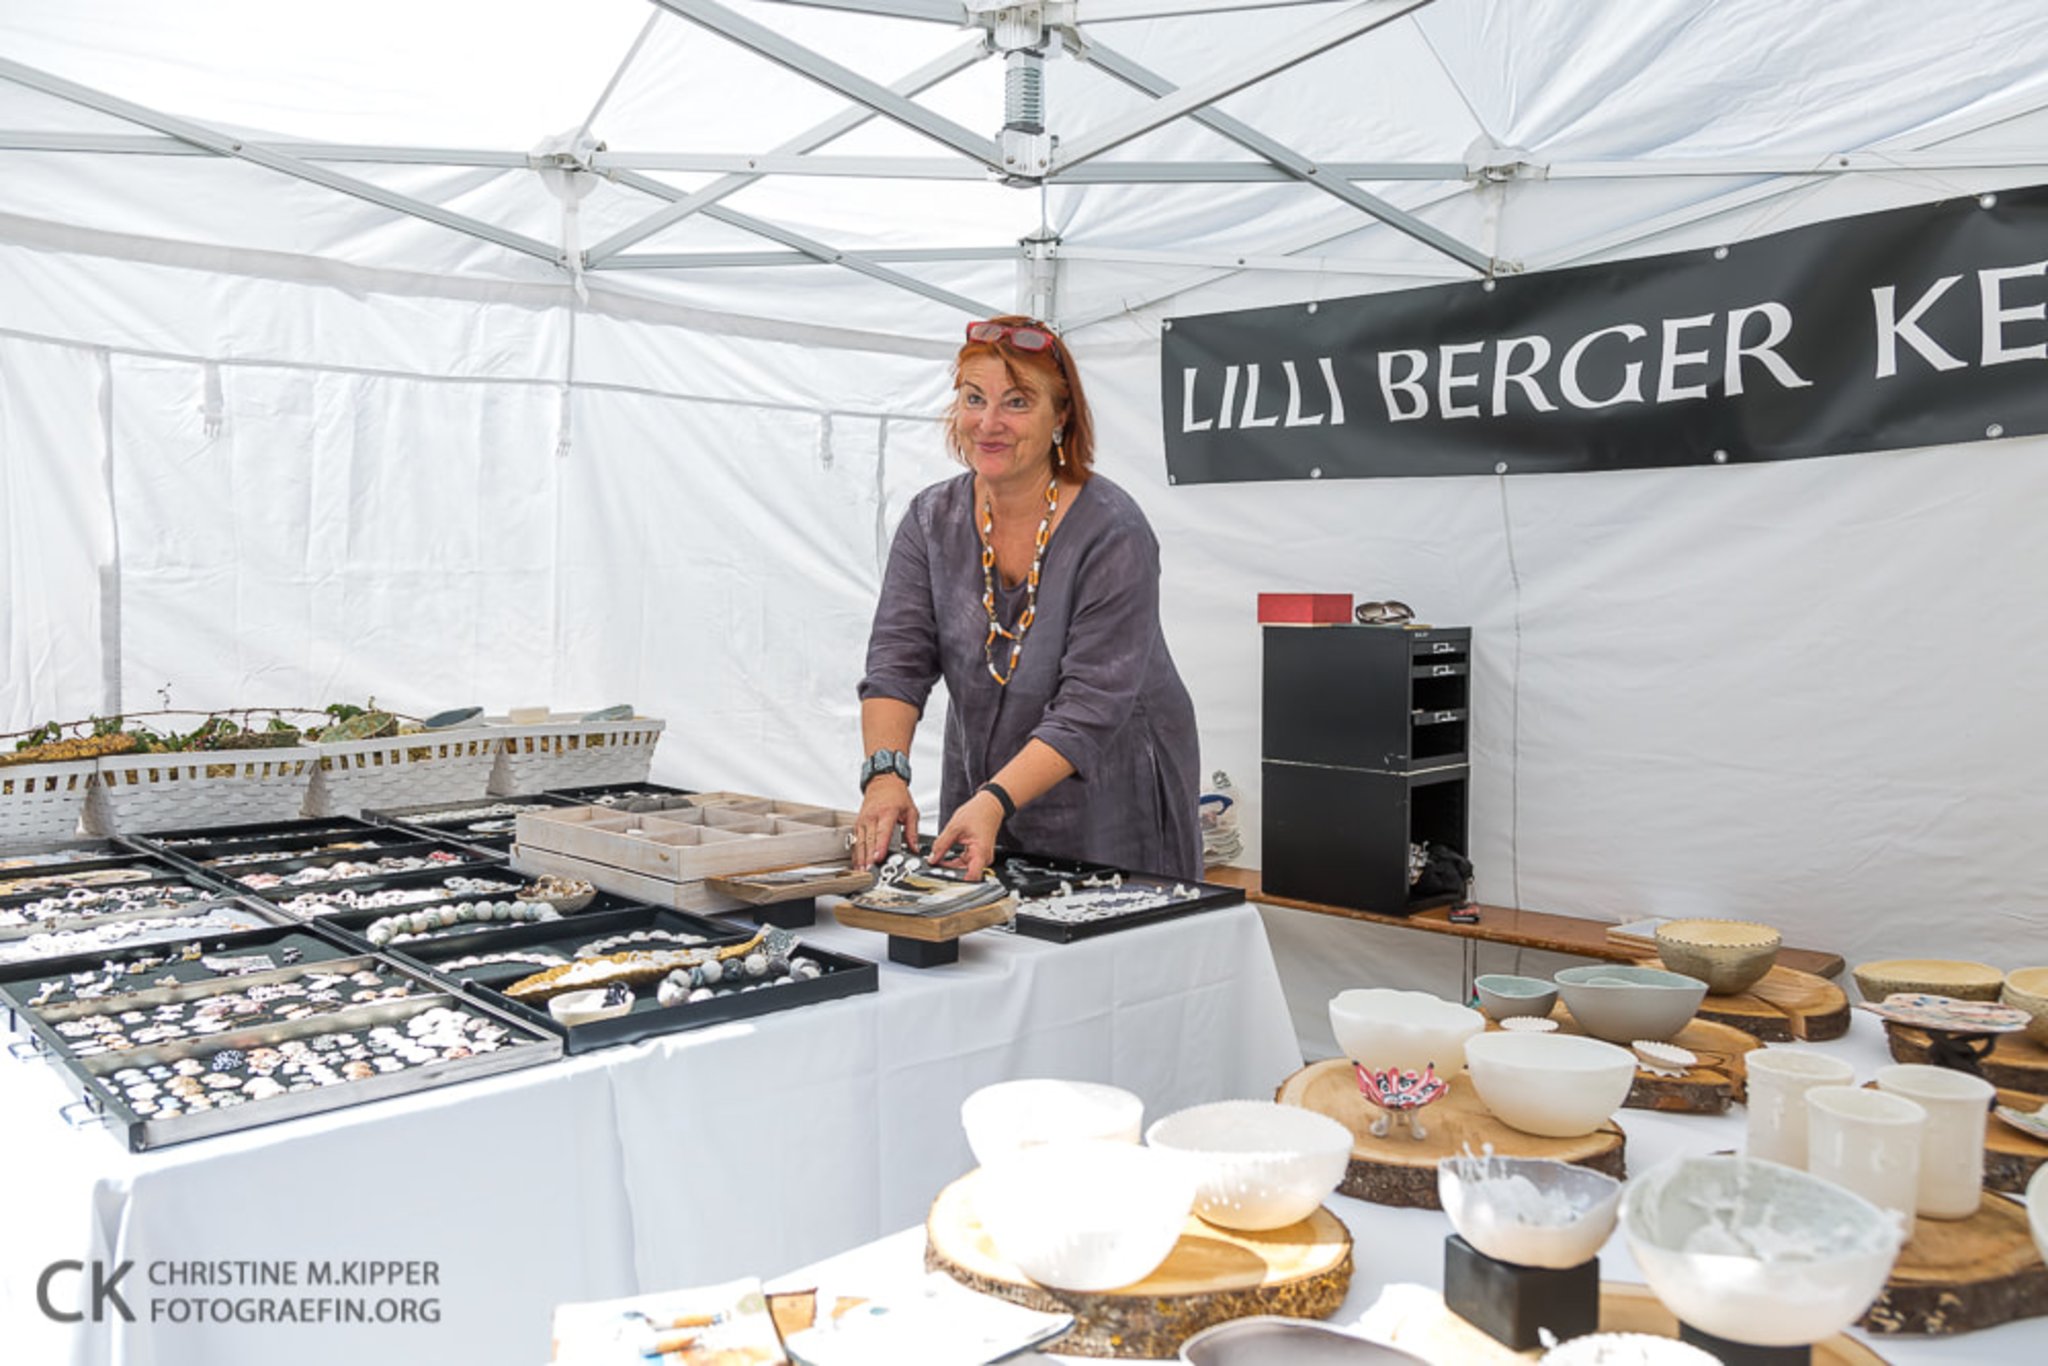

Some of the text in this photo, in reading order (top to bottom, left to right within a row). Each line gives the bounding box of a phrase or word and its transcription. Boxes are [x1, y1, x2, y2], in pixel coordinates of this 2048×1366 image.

[1182, 259, 2048, 433] LILLI BERGER KE
